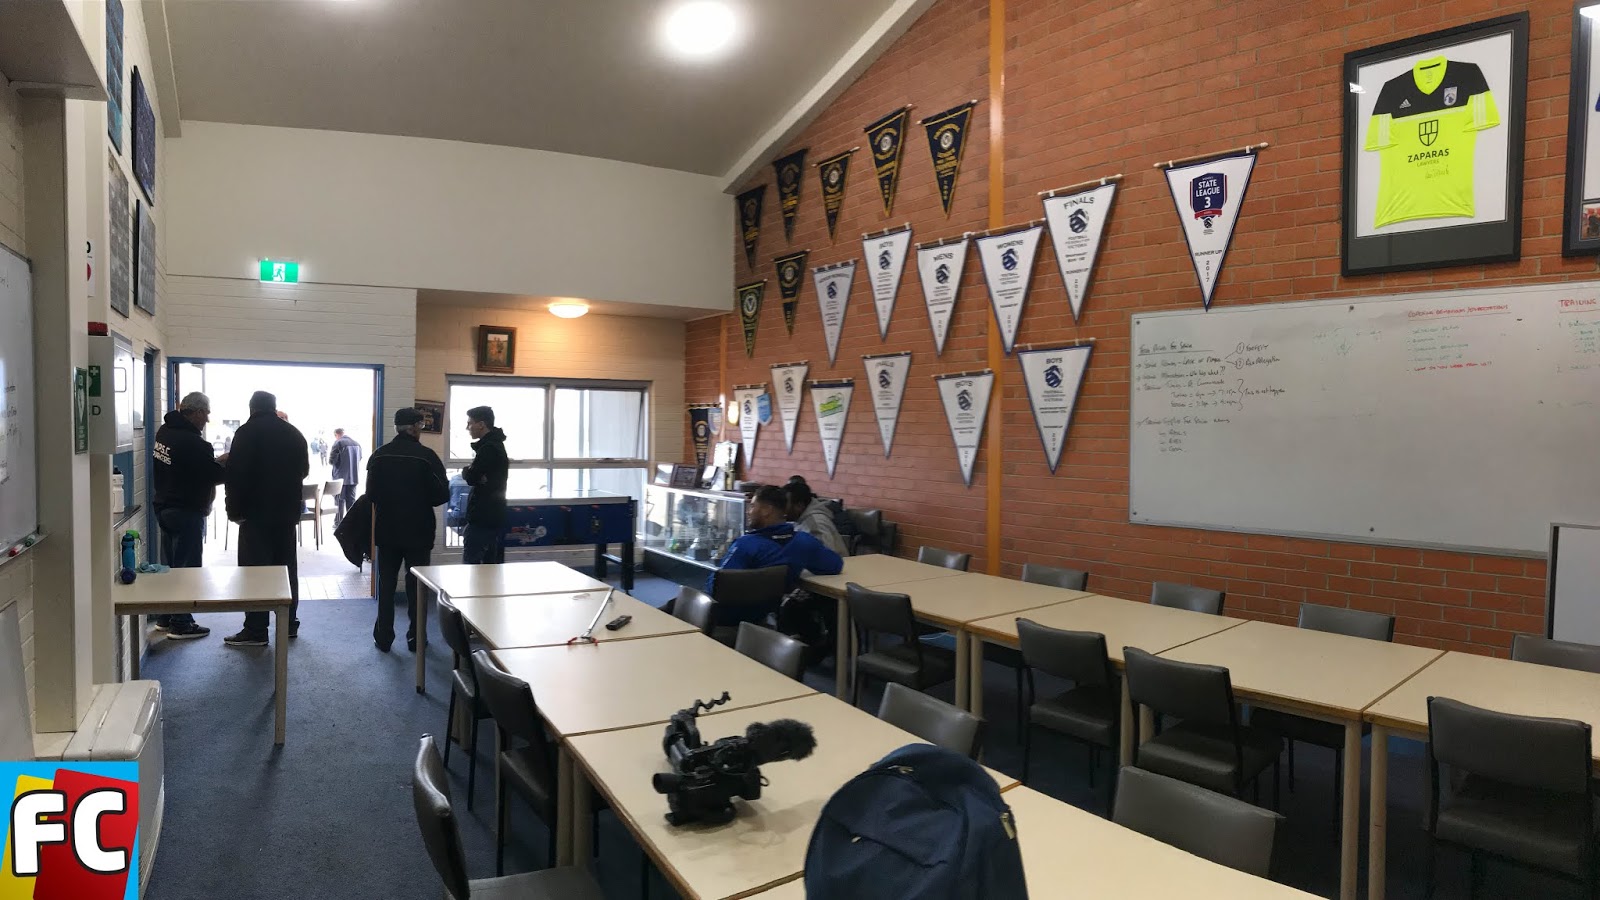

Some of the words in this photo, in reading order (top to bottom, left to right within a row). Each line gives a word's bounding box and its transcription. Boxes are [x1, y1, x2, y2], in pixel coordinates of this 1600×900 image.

[1407, 148, 1450, 163] ZAPARAS
[1416, 159, 1440, 168] LAWYERS
[1198, 179, 1217, 189] STATE
[1195, 186, 1221, 197] LEAGUE
[1063, 196, 1095, 210] FINALS
[1204, 196, 1212, 208] 3
[996, 239, 1024, 250] WOMENS
[933, 252, 954, 262] MENS
[955, 380, 973, 388] BOYS
[89, 405, 101, 416] D
